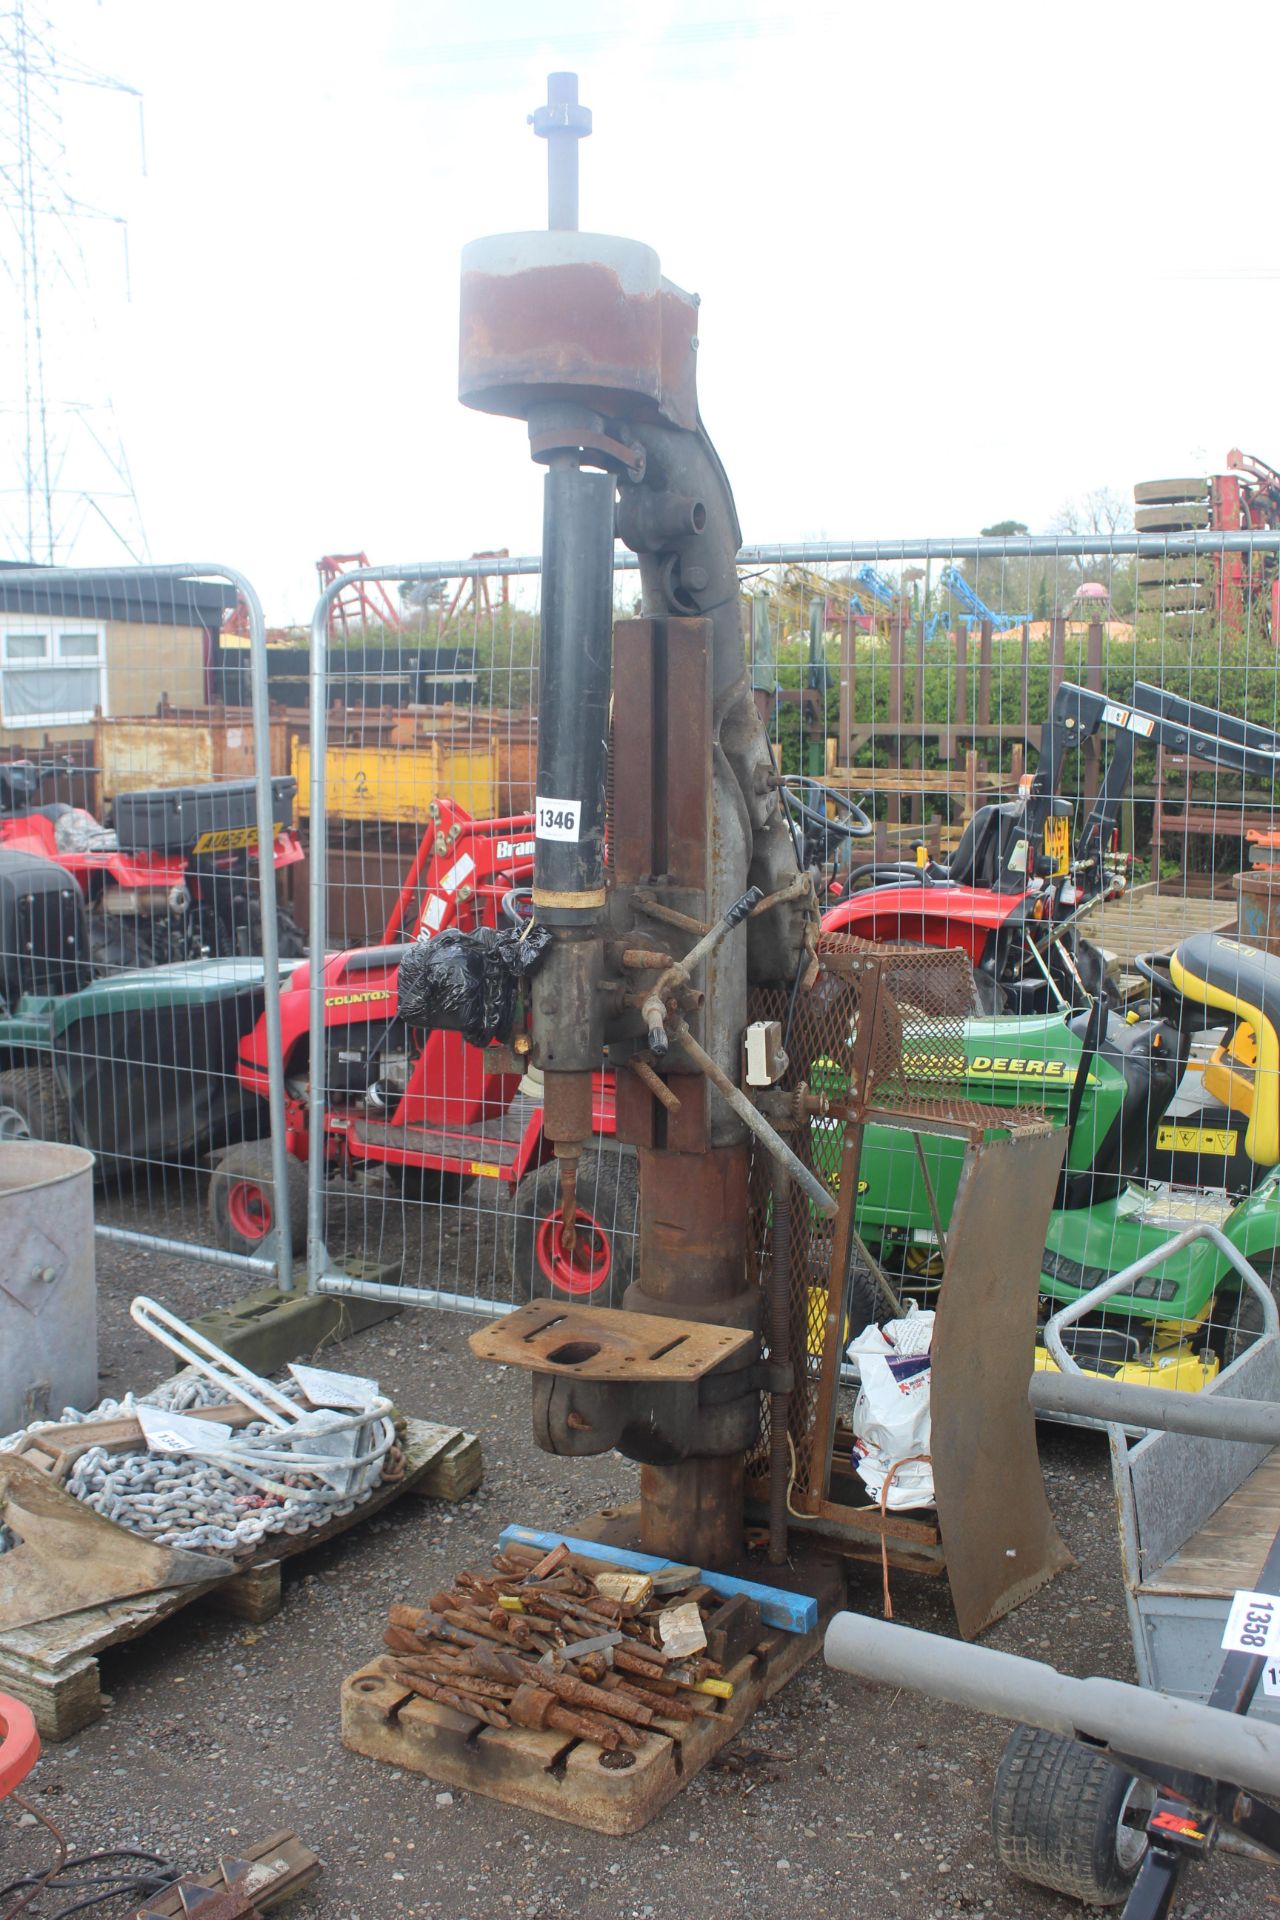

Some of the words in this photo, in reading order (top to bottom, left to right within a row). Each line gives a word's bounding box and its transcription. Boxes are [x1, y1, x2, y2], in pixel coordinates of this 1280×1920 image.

[539, 808, 575, 830] 1346
[496, 840, 536, 859] Bran
[971, 1056, 1066, 1077] DEERE
[1239, 1602, 1275, 1648] 1358
